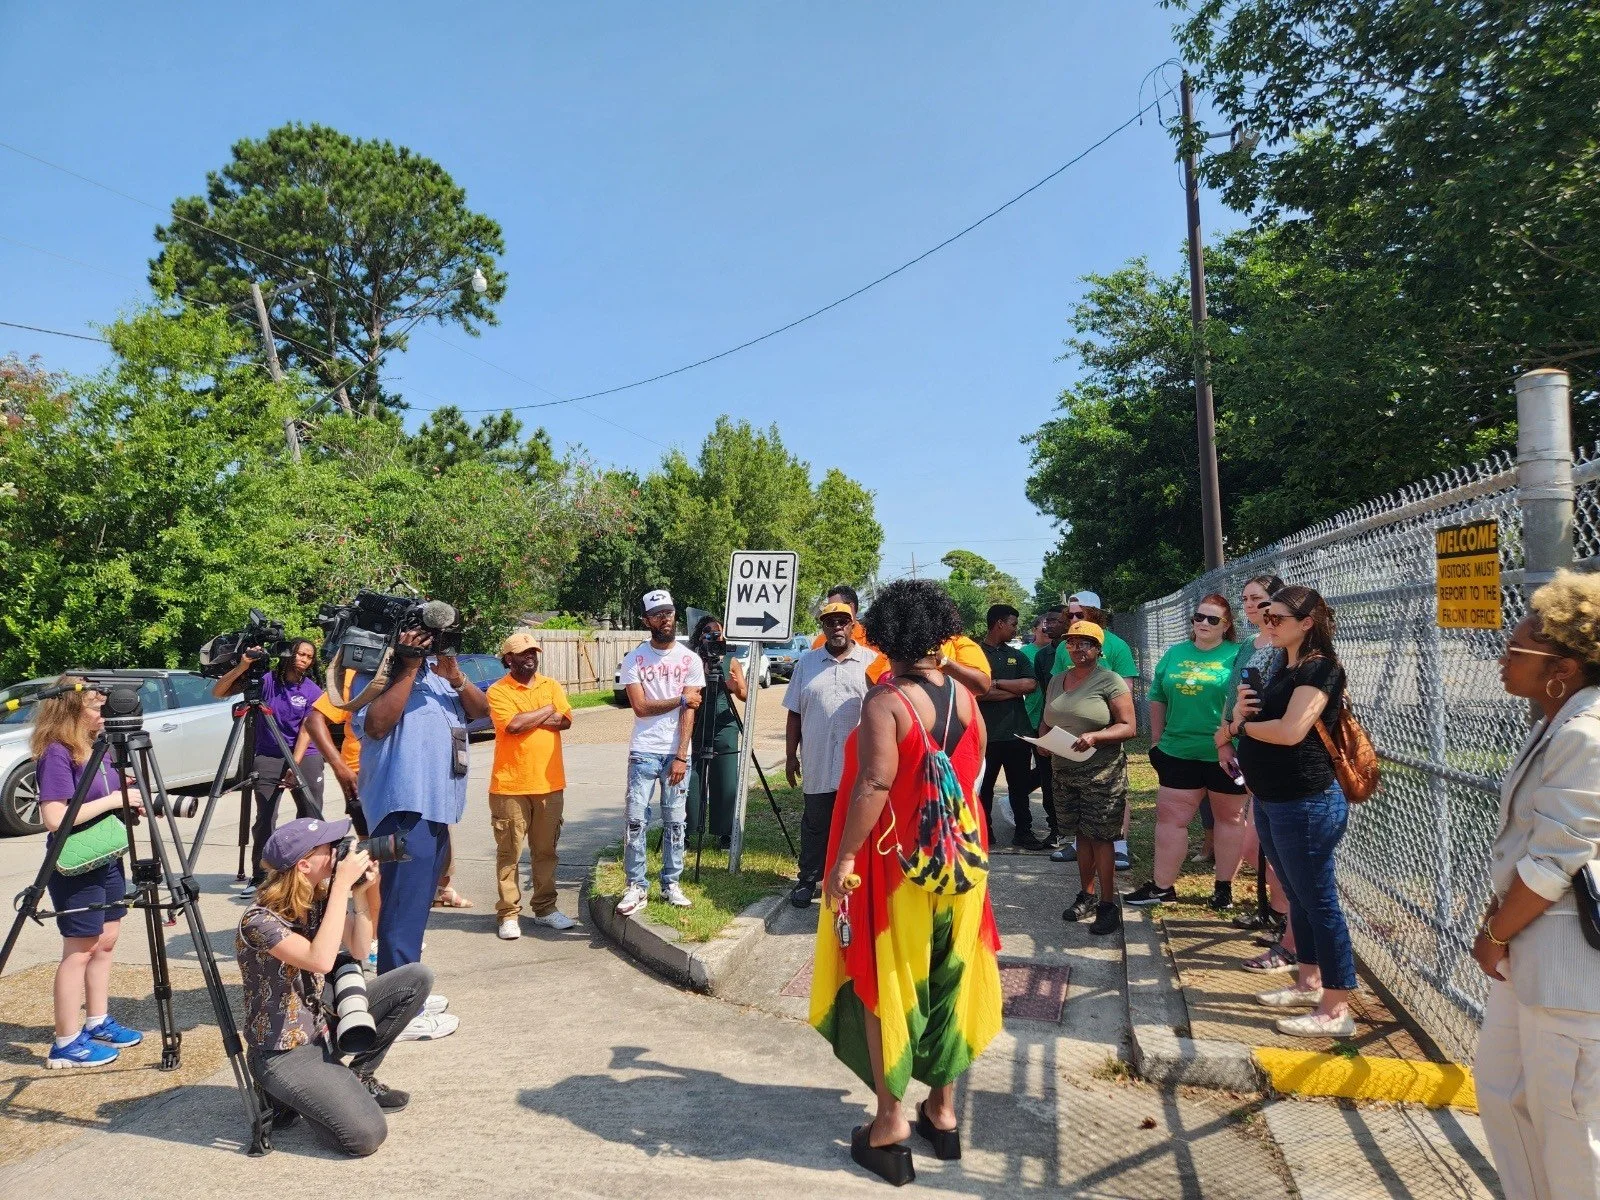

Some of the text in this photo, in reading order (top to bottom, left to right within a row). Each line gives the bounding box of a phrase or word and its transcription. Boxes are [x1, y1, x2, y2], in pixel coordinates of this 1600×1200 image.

[1437, 523, 1497, 553] WELCOME
[740, 560, 788, 579] ONE
[1440, 561, 1495, 579] VISITORS MUST
[737, 584, 787, 603] WAY
[1440, 585, 1497, 600] REPORT TO THE
[1442, 608, 1495, 624] FRONT OFFICE
